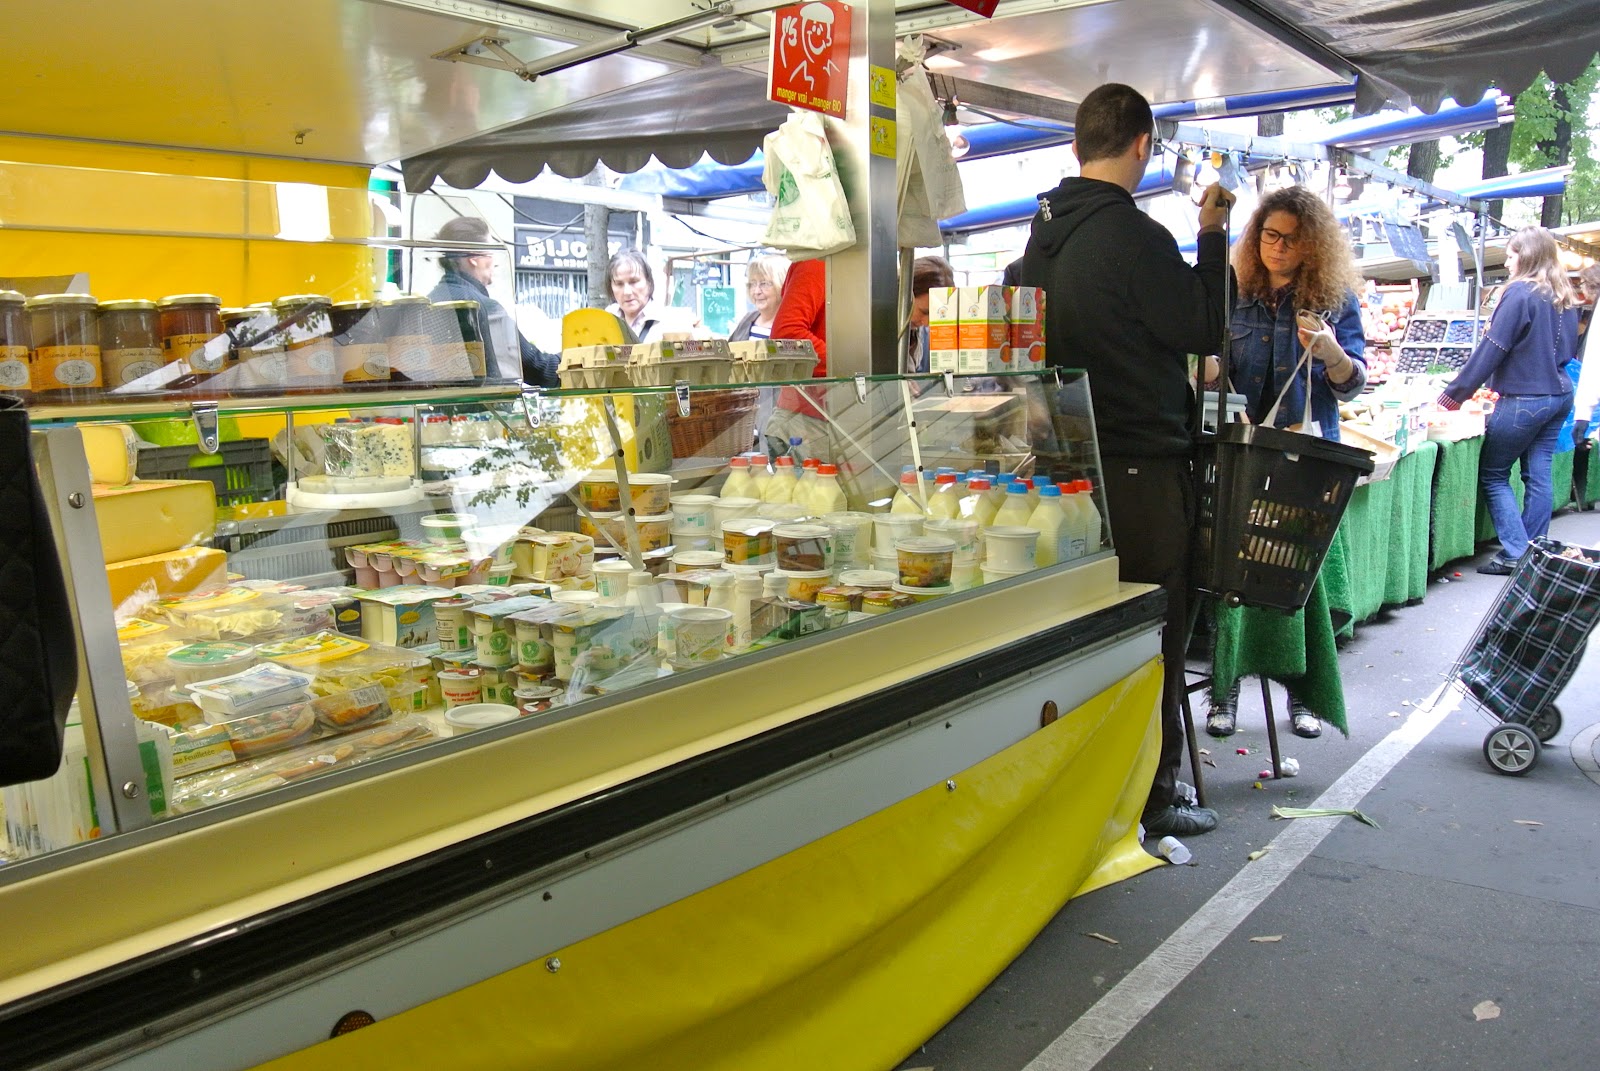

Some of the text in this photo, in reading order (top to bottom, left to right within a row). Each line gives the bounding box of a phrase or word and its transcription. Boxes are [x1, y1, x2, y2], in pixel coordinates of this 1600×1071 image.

[776, 87, 797, 102] manger
[797, 91, 808, 104] vrai
[184, 749, 216, 762] Feuilletée
